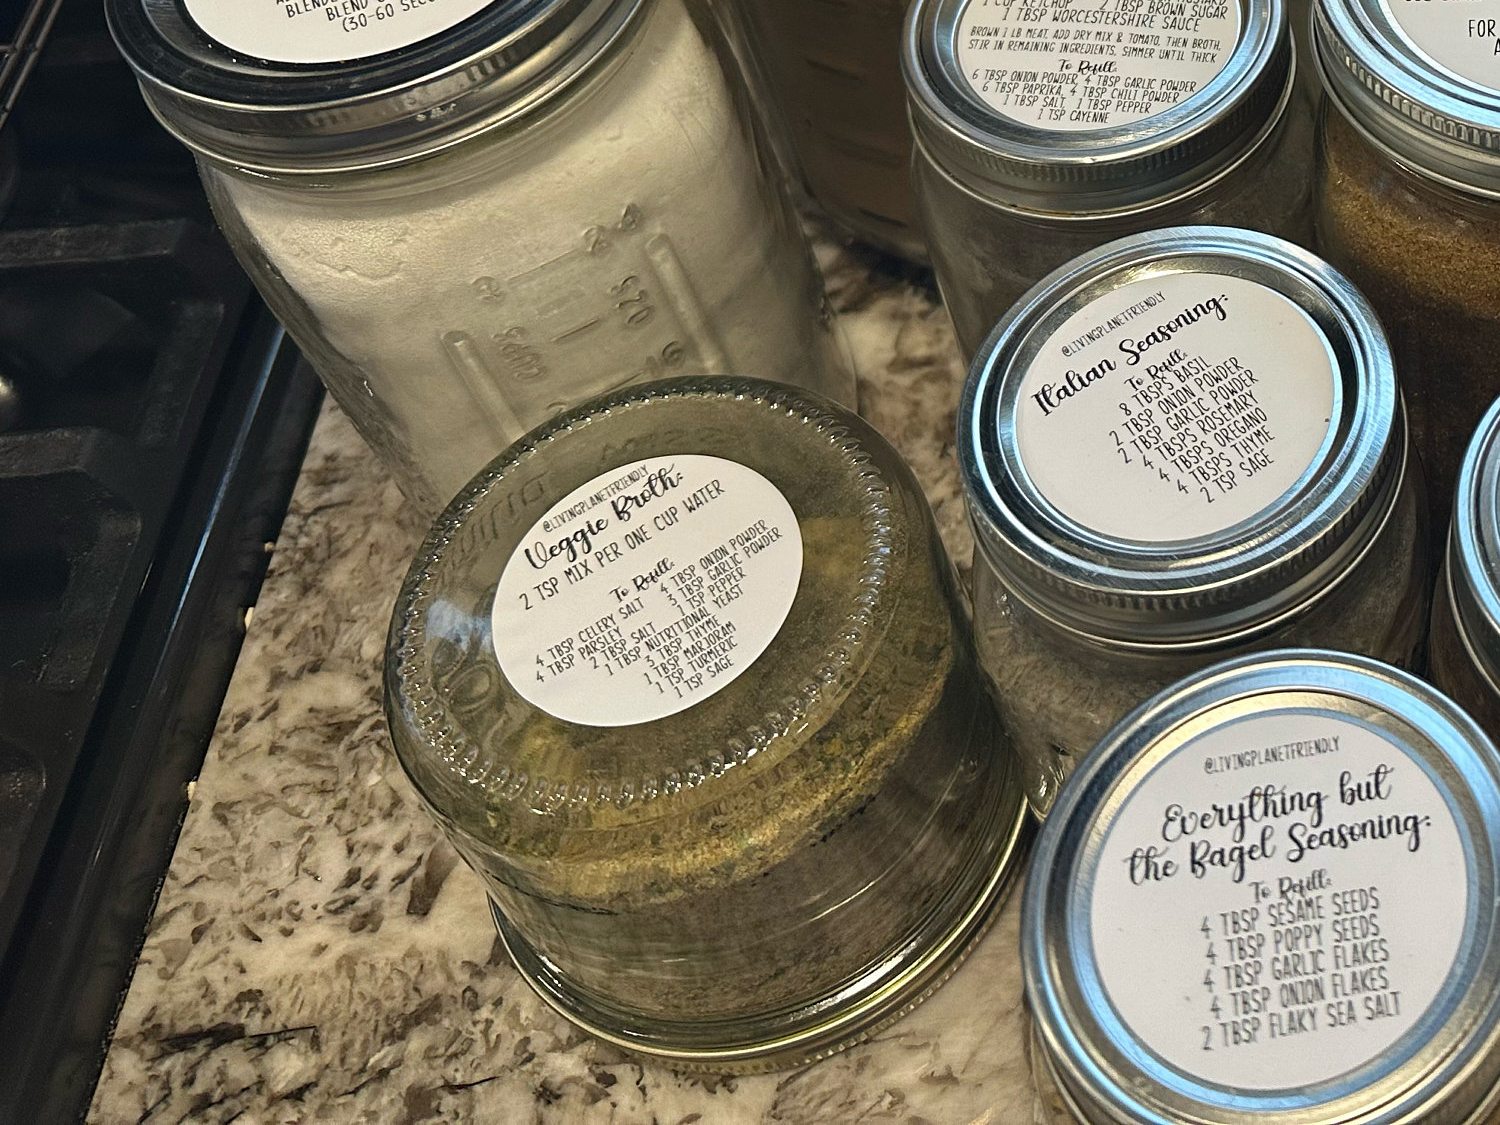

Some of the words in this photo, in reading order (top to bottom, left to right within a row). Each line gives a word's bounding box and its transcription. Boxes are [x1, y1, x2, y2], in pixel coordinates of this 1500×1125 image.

[1037, 108, 1042, 120] 1
[1048, 109, 1065, 121] TSP
[1069, 110, 1111, 124] CAYENNE
[1031, 359, 1116, 416] Italian
[1119, 293, 1229, 365] Seasoning:
[1061, 291, 1167, 357] @LIVINGPLANETFRIENDLY
[1119, 402, 1132, 416] 8
[1132, 379, 1173, 409] TBSPS
[1174, 356, 1211, 384] BASIL
[543, 464, 649, 532] @LIVINGPLANETFRIENDLY
[1200, 487, 1214, 503] 2
[1212, 474, 1236, 496] TSP
[1240, 450, 1275, 477] SAGE
[518, 592, 532, 610] 2
[534, 577, 560, 601] TSP
[564, 559, 594, 585] MIX
[595, 540, 624, 567] PER
[626, 524, 653, 550] ONE
[654, 506, 679, 532] CUP
[682, 479, 725, 513] WATER
[525, 517, 609, 569] Veggie
[611, 463, 684, 522] Broth:
[1204, 736, 1341, 774] @LIVINGPLANETFRIENDLY
[1162, 784, 1329, 843] Everything
[1340, 764, 1394, 803] but
[1125, 845, 1180, 885] the
[1190, 826, 1277, 883] Bagel
[1286, 815, 1432, 863] Seasoning:
[1202, 1026, 1213, 1050] 2
[1220, 1017, 1261, 1047] TBSP
[1268, 1010, 1318, 1039] FLAKY
[1327, 1001, 1356, 1027] SEA
[1365, 992, 1402, 1019] SALT
